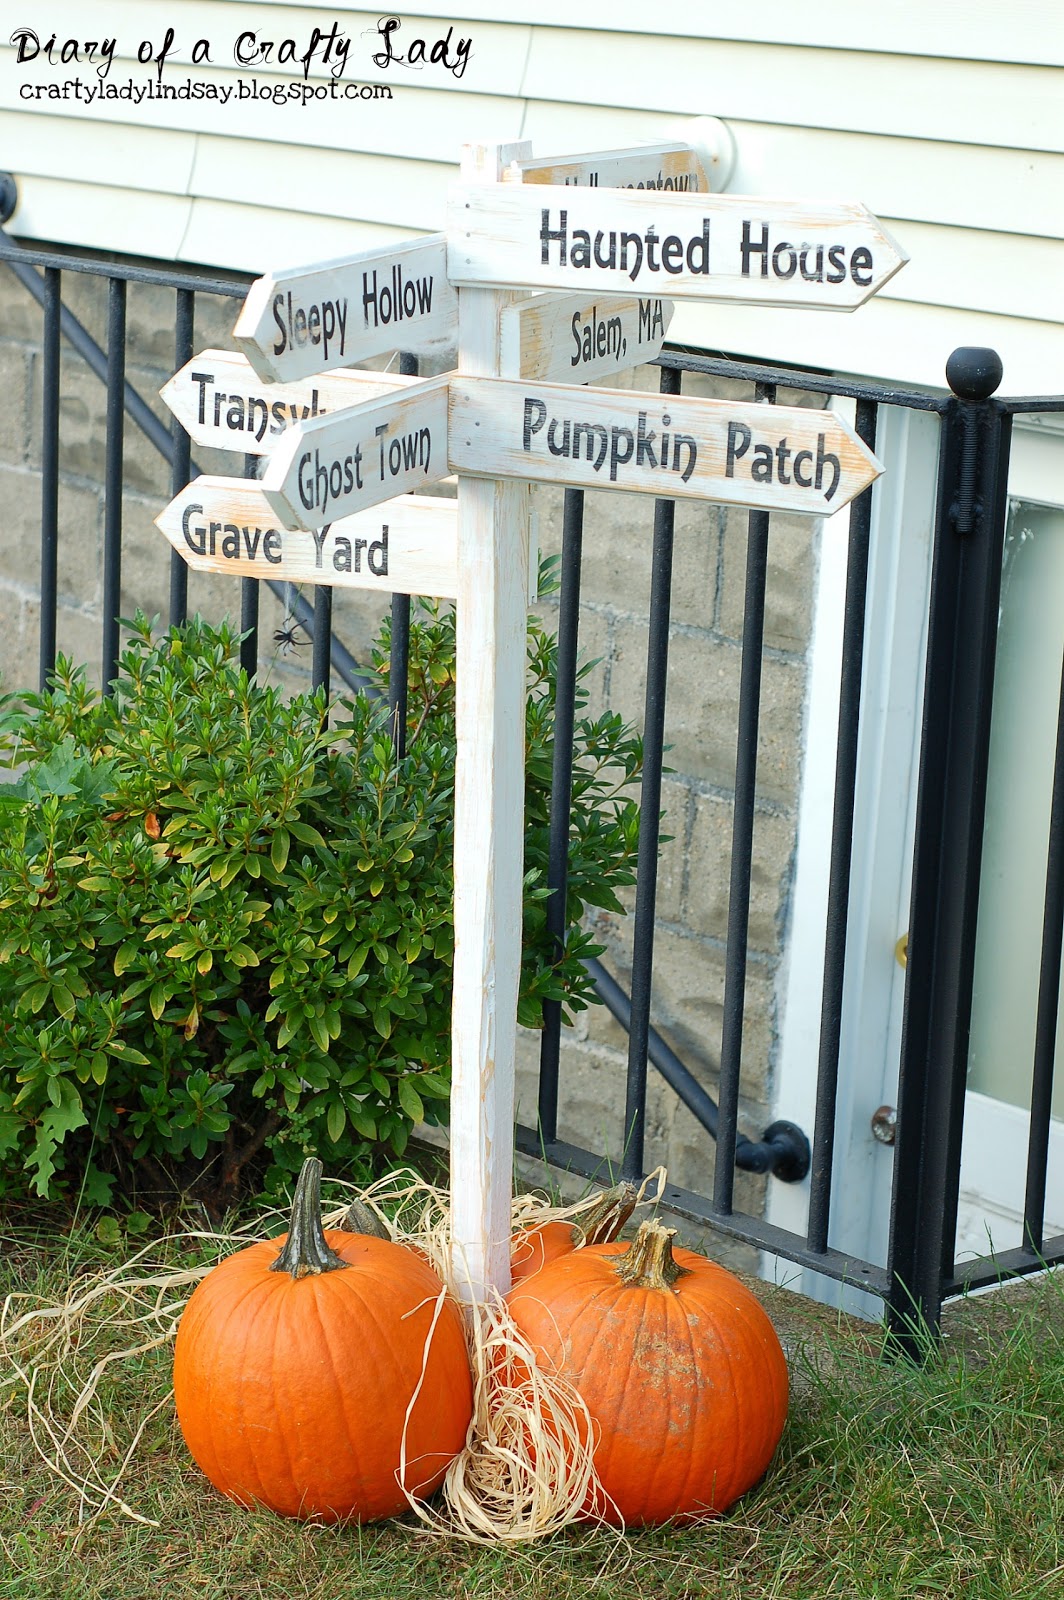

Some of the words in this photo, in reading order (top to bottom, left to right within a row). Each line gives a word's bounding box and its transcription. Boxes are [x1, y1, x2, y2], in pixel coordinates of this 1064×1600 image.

[540, 208, 710, 282] Haunted
[740, 220, 874, 287] House
[273, 291, 348, 360] Sleepy
[362, 264, 433, 329] Hollow
[571, 306, 627, 367] Salem,
[638, 298, 664, 344] MA
[299, 443, 363, 515] Ghost
[375, 423, 431, 481] Town
[523, 397, 697, 482] Pumpkin
[725, 421, 841, 502] Patch
[182, 503, 282, 564] Grave
[312, 523, 389, 576] Yard
